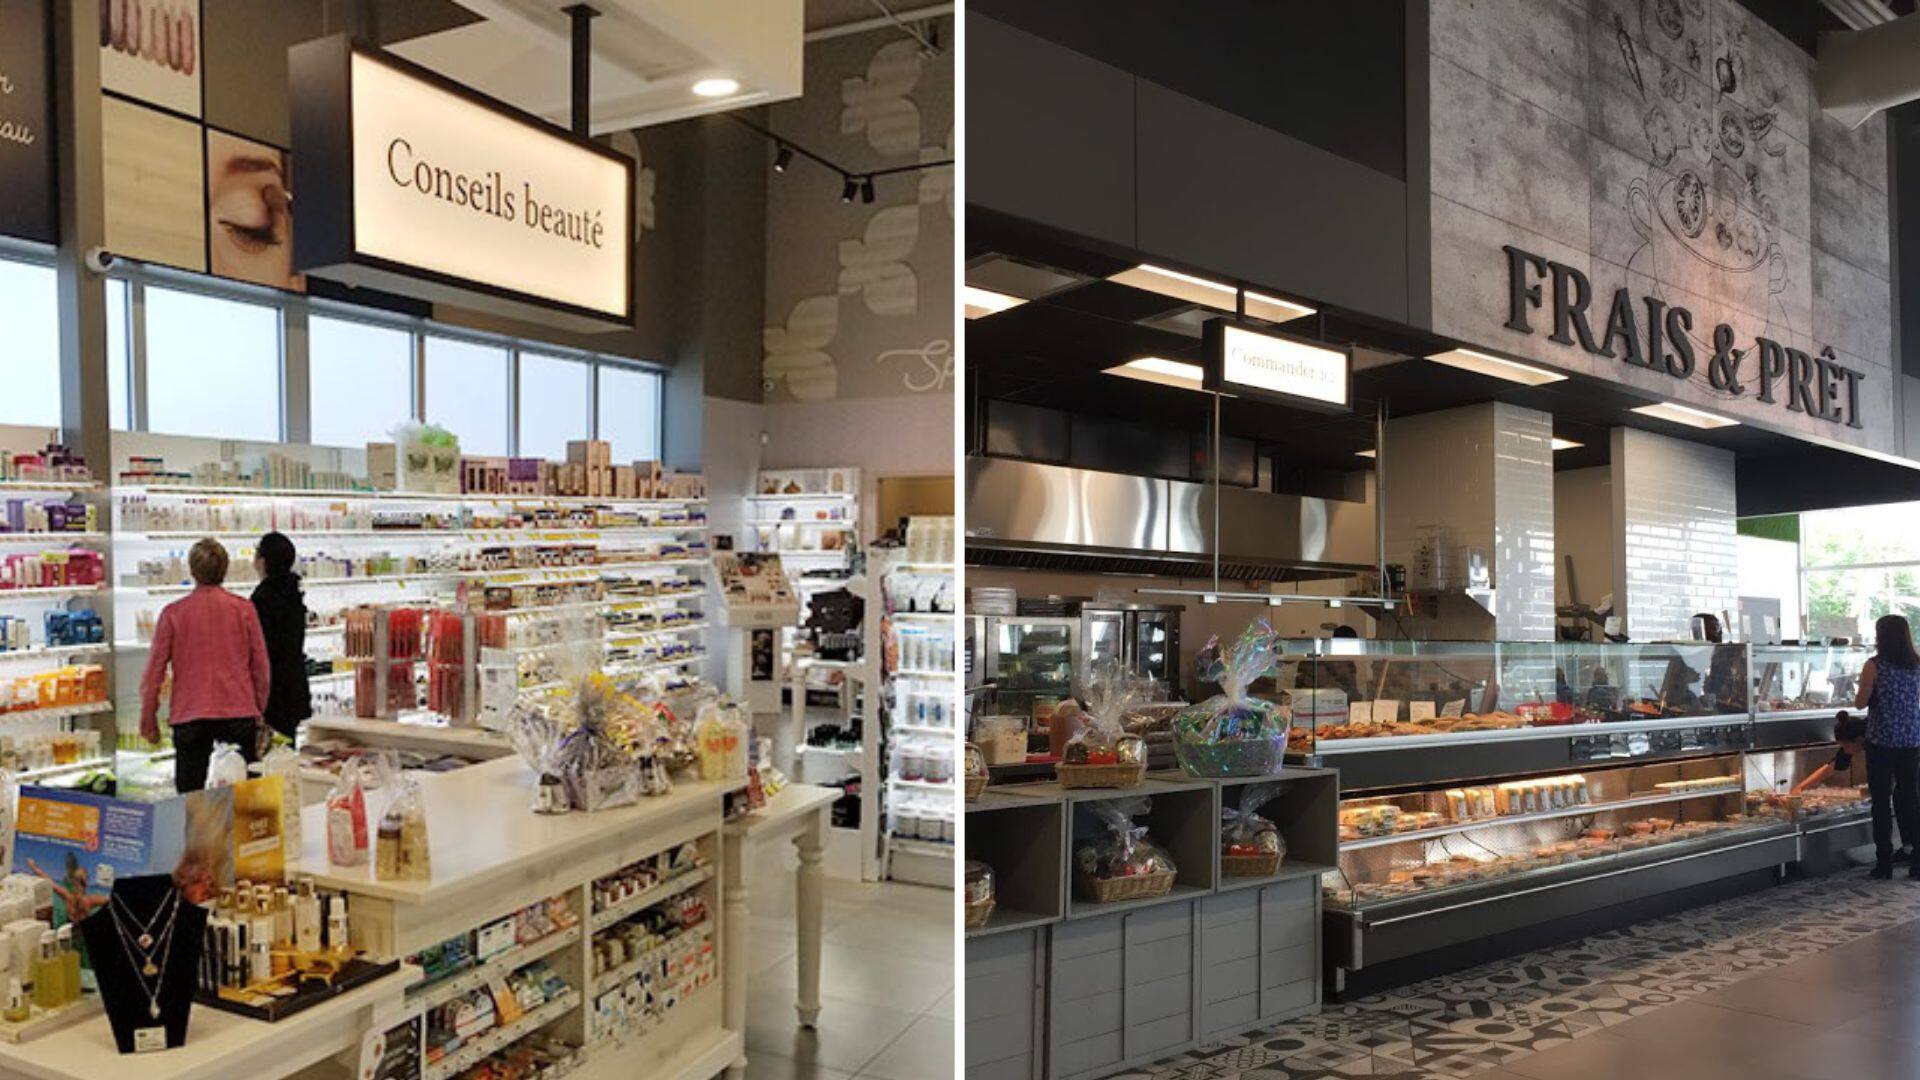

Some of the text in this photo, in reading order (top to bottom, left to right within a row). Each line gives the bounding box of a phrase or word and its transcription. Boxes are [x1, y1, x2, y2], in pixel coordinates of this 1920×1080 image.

[0, 121, 36, 145] au
[387, 137, 604, 249] Conseils beauté
[1231, 347, 1315, 379] Commander
[1502, 244, 1866, 430] FRAIS & PRÊT
